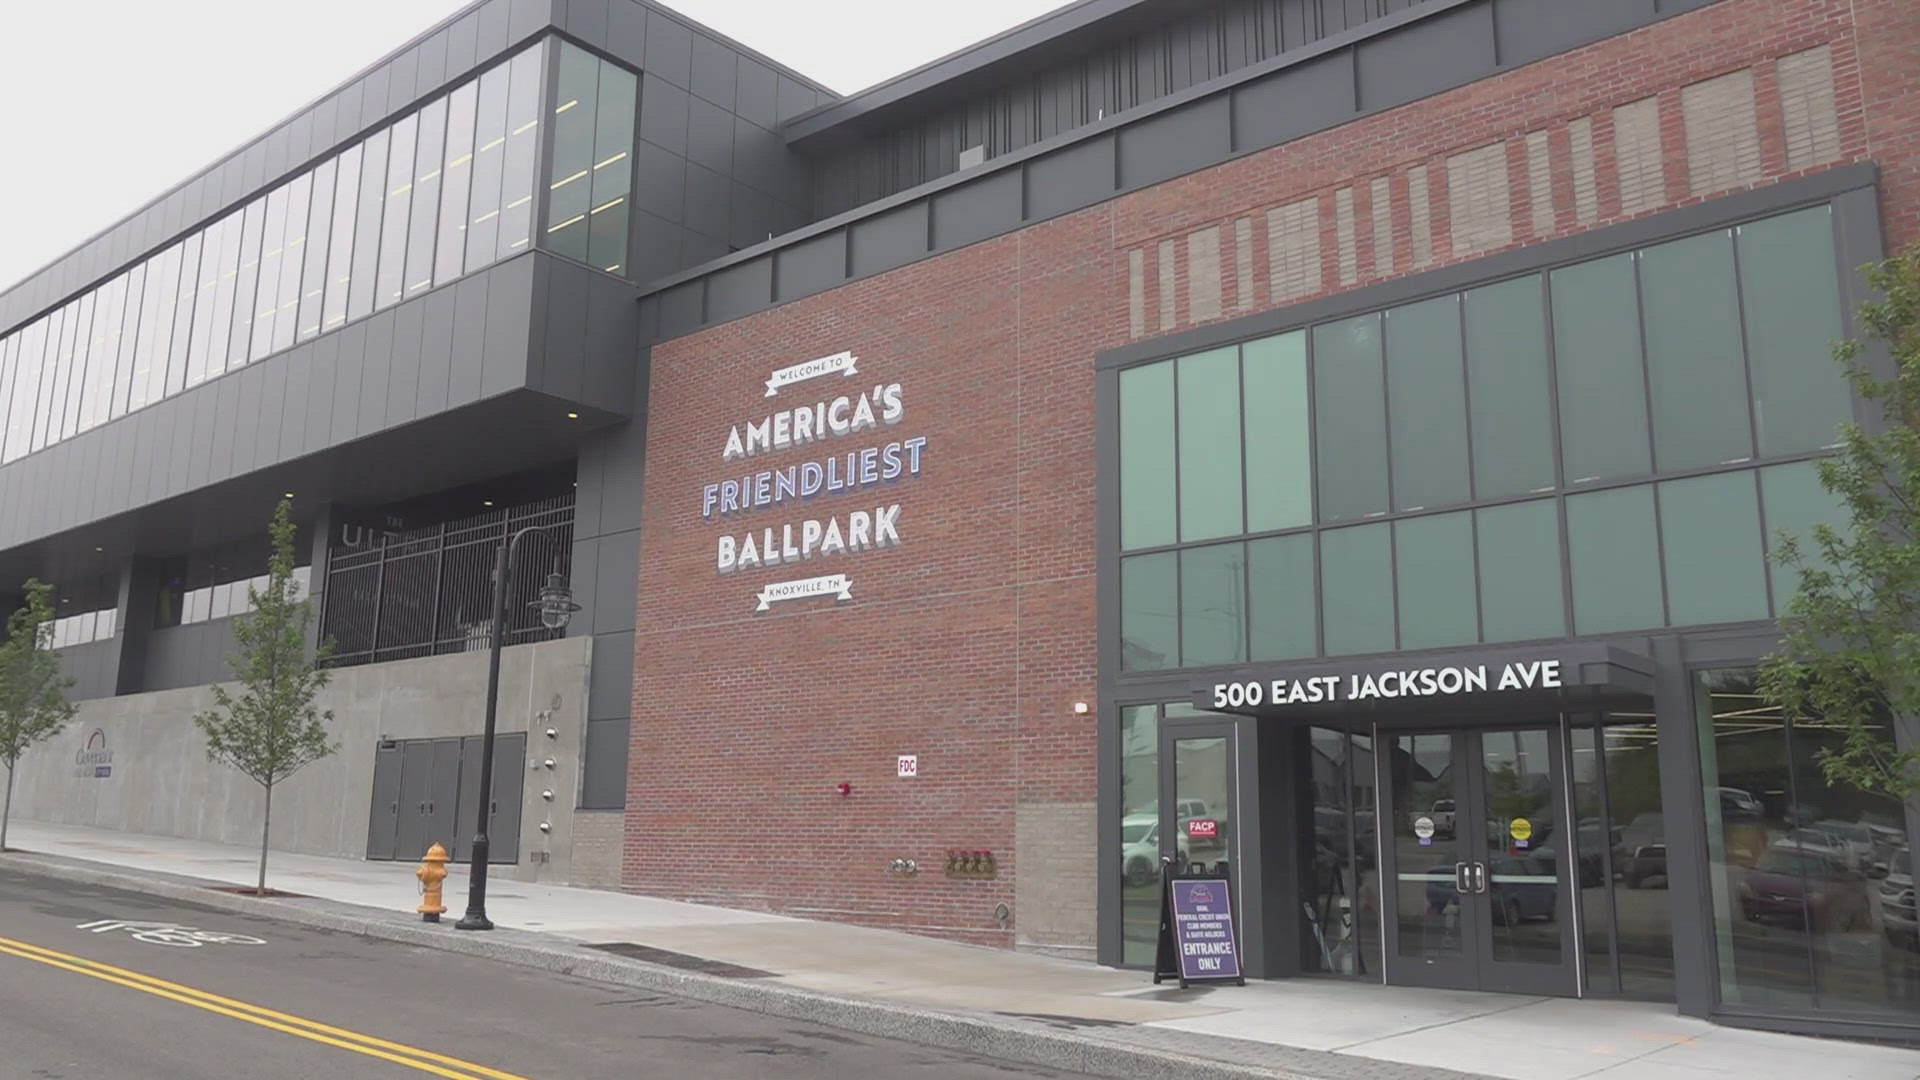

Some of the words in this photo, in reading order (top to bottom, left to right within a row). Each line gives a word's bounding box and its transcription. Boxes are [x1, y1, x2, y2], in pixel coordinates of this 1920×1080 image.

[780, 362, 826, 380] WELCOME
[829, 357, 843, 367] TO
[722, 383, 903, 460] AMERICA'S
[702, 436, 926, 518] FRIENDLIEST
[717, 504, 901, 571] BALLPARK
[769, 581, 824, 597] KNOXVILLE,
[828, 579, 840, 588] TN
[1214, 681, 1263, 708] 500
[1271, 676, 1340, 705] EAST
[1348, 665, 1487, 700] JACKSON
[1498, 660, 1562, 691] AVE
[900, 759, 915, 772] FDC
[1189, 821, 1215, 831] FACP
[1183, 942, 1232, 956] ENTRANCE
[1198, 957, 1221, 970] ONLY
